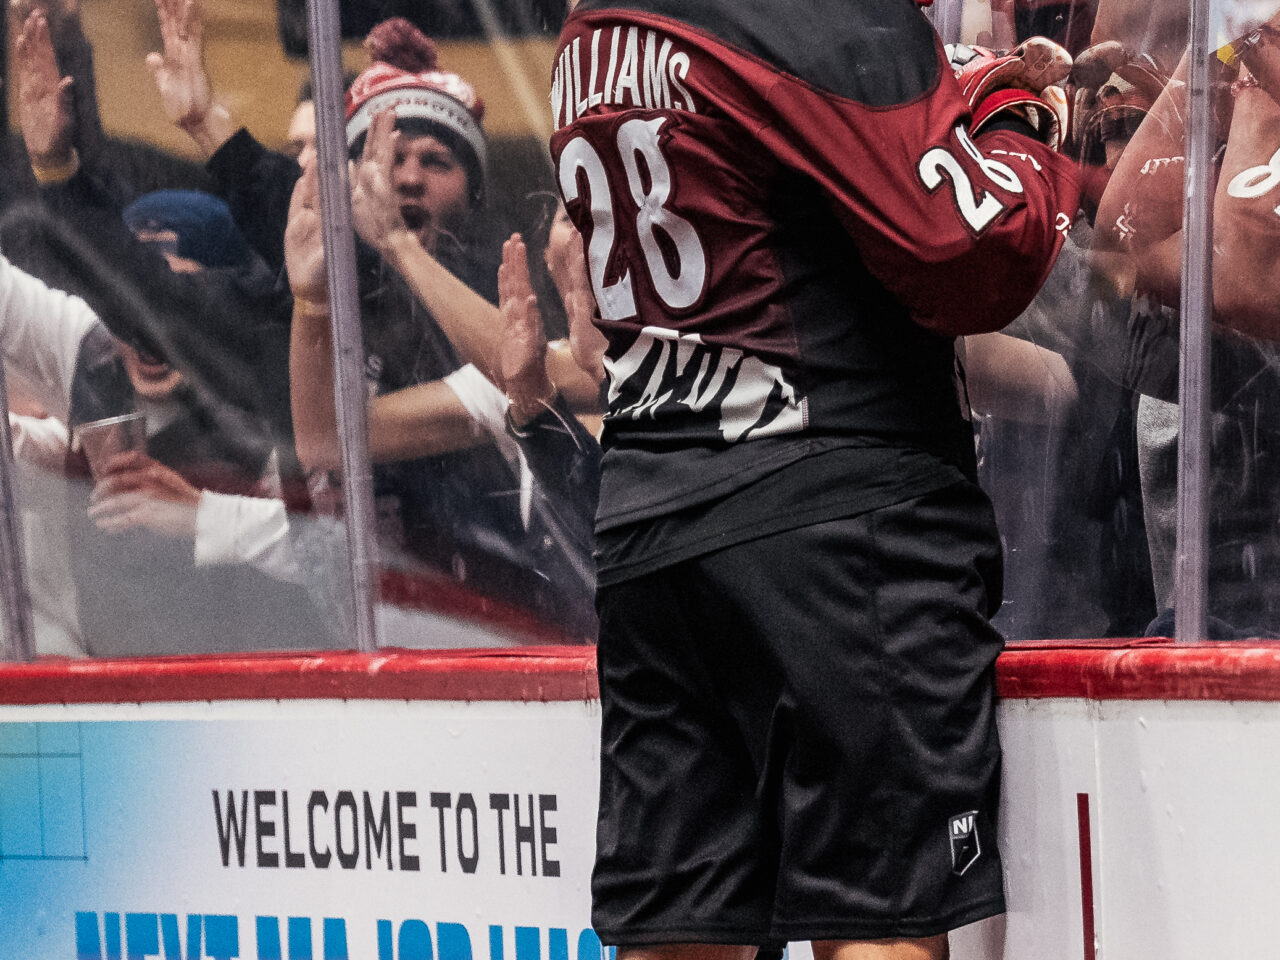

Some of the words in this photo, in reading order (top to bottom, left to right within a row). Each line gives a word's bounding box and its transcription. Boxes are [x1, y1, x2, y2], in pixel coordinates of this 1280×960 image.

[550, 26, 696, 132] WILLIAMS
[559, 117, 706, 321] 28
[919, 124, 1024, 233] 28
[212, 790, 419, 871] WELCOME
[430, 792, 478, 874] TO
[489, 793, 560, 877] THE
